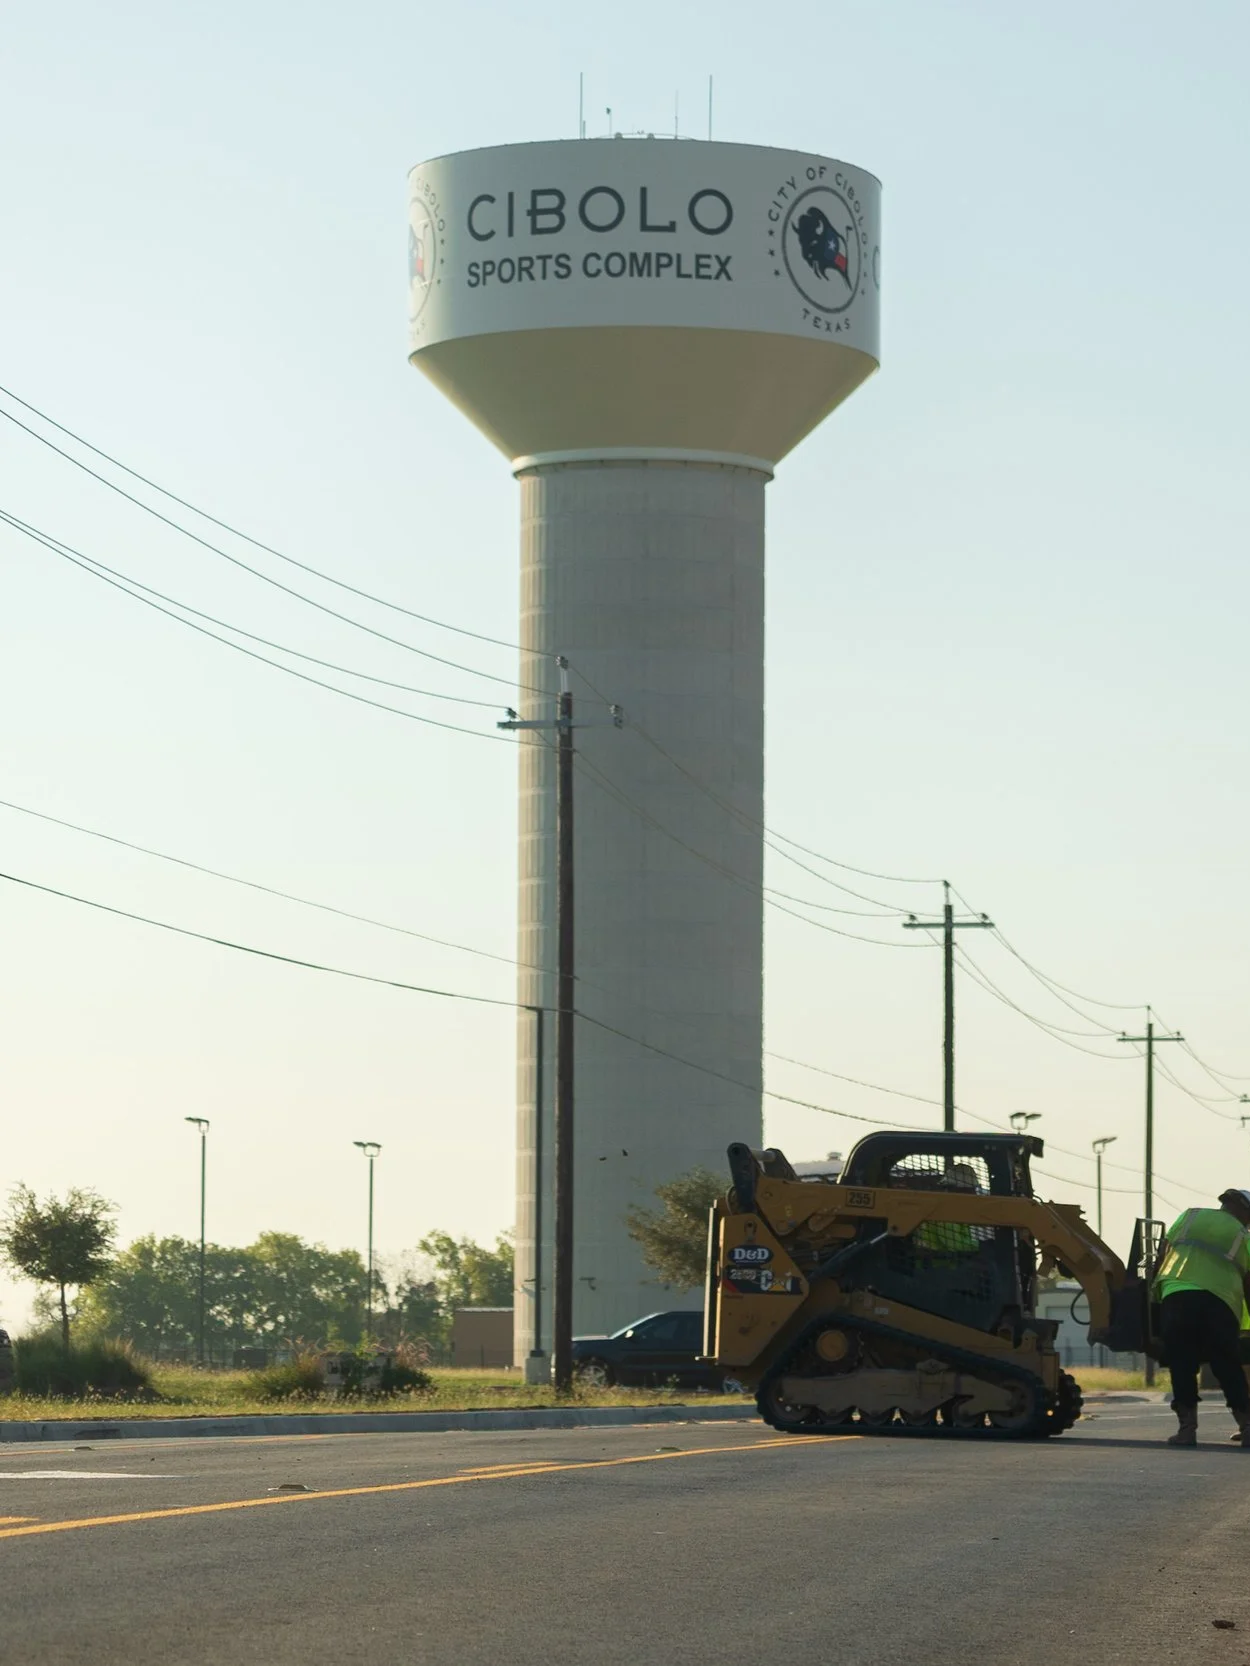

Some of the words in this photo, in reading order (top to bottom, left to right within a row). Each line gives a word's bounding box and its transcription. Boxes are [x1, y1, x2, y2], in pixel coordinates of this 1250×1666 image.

[467, 185, 734, 242] CIBOLO
[768, 176, 798, 222] CITY
[806, 166, 827, 181] OF
[834, 172, 868, 246] CIBOLO
[467, 253, 573, 288] SPORTS
[582, 251, 734, 282] COMPLEX
[801, 307, 851, 333] TEXAS
[733, 1248, 769, 1260] D&D
